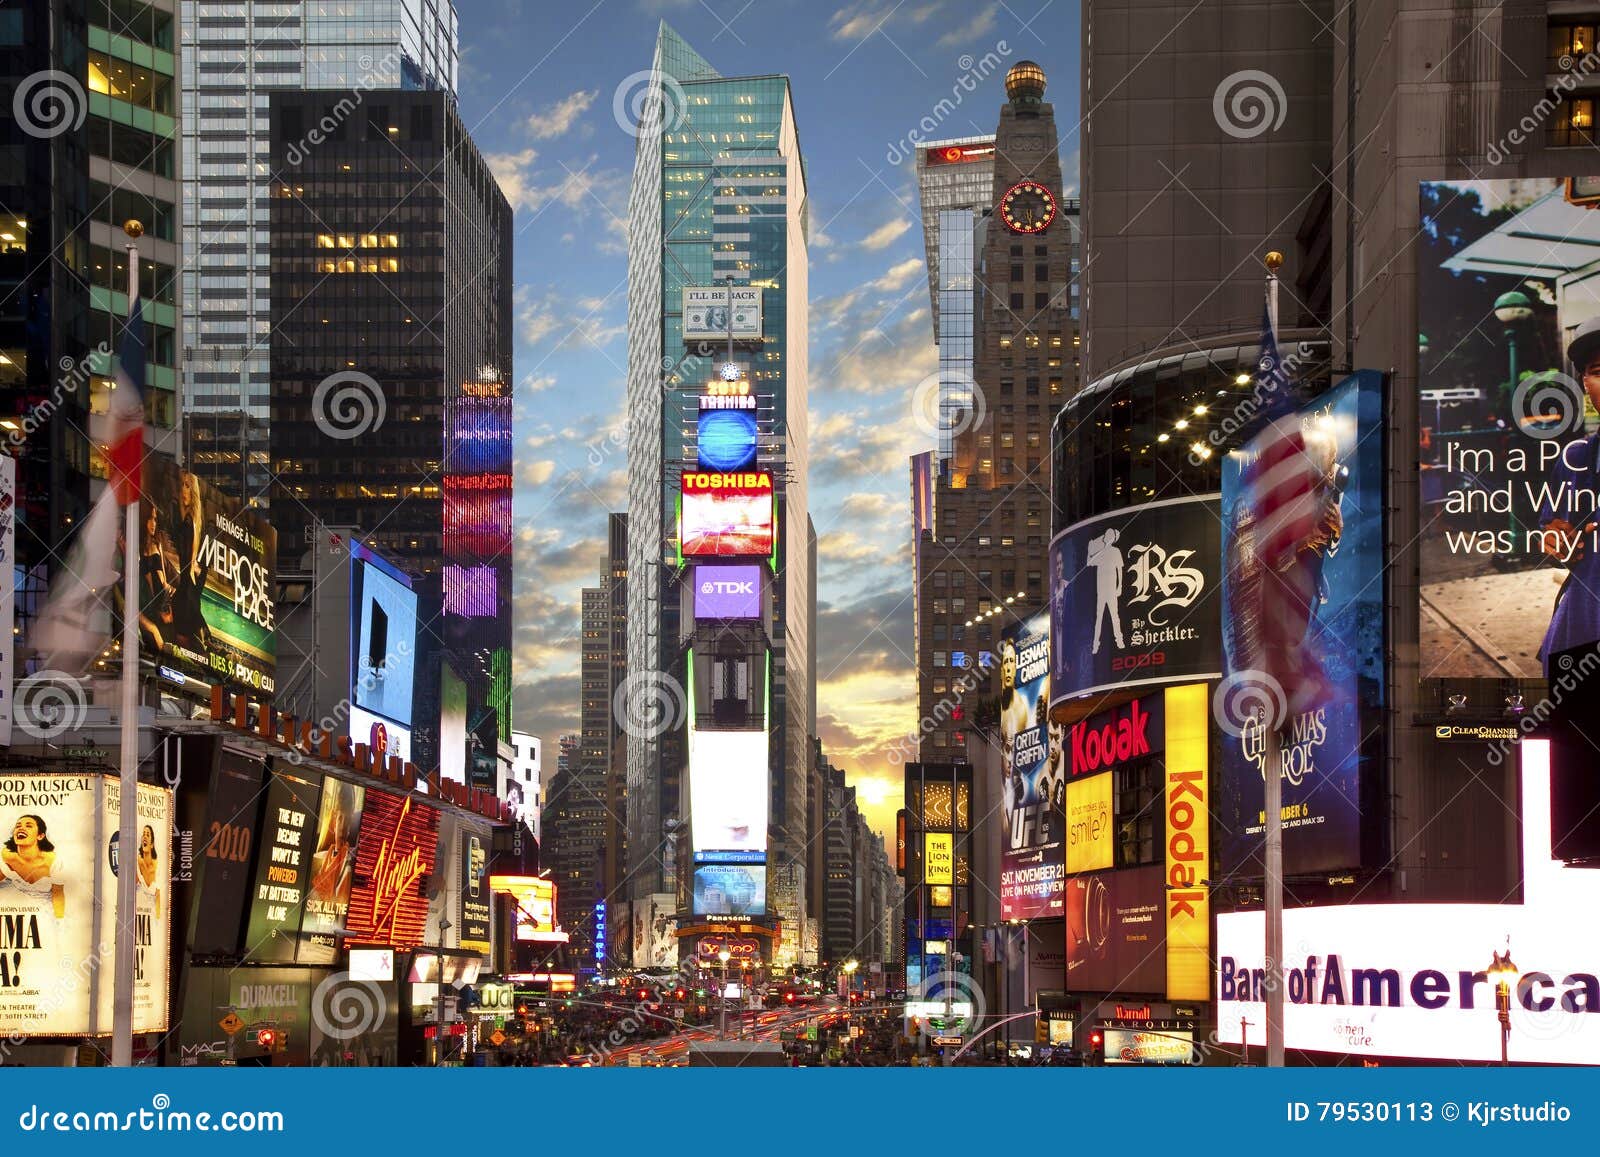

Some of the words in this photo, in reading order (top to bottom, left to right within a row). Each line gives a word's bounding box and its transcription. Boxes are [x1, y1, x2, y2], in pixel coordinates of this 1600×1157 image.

[689, 292, 709, 300] I'LL
[711, 292, 725, 300] BE
[708, 381, 749, 395] 2010
[699, 395, 756, 409] TOSHIBA
[1447, 442, 1494, 472] I'm
[1506, 448, 1526, 472] a
[1539, 440, 1588, 472] PC
[683, 474, 770, 488] TOSHIBA
[1445, 480, 1512, 513] and
[1445, 530, 1513, 554] was
[1526, 529, 1582, 562] my
[197, 534, 269, 600] MELROSE
[713, 582, 753, 594] TDK
[234, 582, 274, 631] PLACE
[1131, 619, 1145, 629] By
[1130, 627, 1194, 647] Sheckler
[1015, 640, 1048, 669] LESNAR
[1112, 651, 1165, 671] 2009
[1016, 728, 1040, 751] ORTIZ
[1015, 743, 1046, 767] GRIFFIN
[1262, 742, 1317, 785] ROL
[0, 779, 25, 792] OD
[31, 779, 93, 792] MUSICAL
[278, 807, 291, 824] THE
[290, 812, 305, 828] NEW
[1260, 804, 1300, 823] NMBER
[1302, 803, 1308, 816] 6
[1011, 801, 1051, 849] UFC
[1071, 811, 1107, 845] smile?
[205, 821, 250, 862] 2010
[276, 828, 301, 846] DECADE
[931, 842, 946, 850] THE
[1169, 770, 1205, 920] Kodak
[180, 830, 193, 867] COMING
[291, 850, 300, 865] BE
[725, 854, 765, 862] Corporation
[929, 852, 949, 863] LION
[180, 871, 192, 881] IS
[268, 866, 297, 884] POWERED
[929, 865, 949, 877] KING
[1001, 872, 1015, 885] SAT.
[1015, 864, 1055, 884] NOVEMBER
[1057, 864, 1065, 878] 21
[258, 884, 268, 900] BY
[268, 886, 300, 903] BATTERIES
[1001, 886, 1014, 897] LIVE
[1014, 886, 1022, 896] ON
[1024, 881, 1065, 895] PAY-PER-VIEW
[267, 905, 287, 922] ALONE
[306, 900, 323, 913] SICK
[323, 902, 335, 914] ALL
[336, 903, 348, 915] THE
[1221, 956, 1281, 1002] Ban
[1289, 955, 1317, 1004] of
[240, 984, 297, 1009] DURACELL
[1103, 1021, 1194, 1029] MARQUIS
